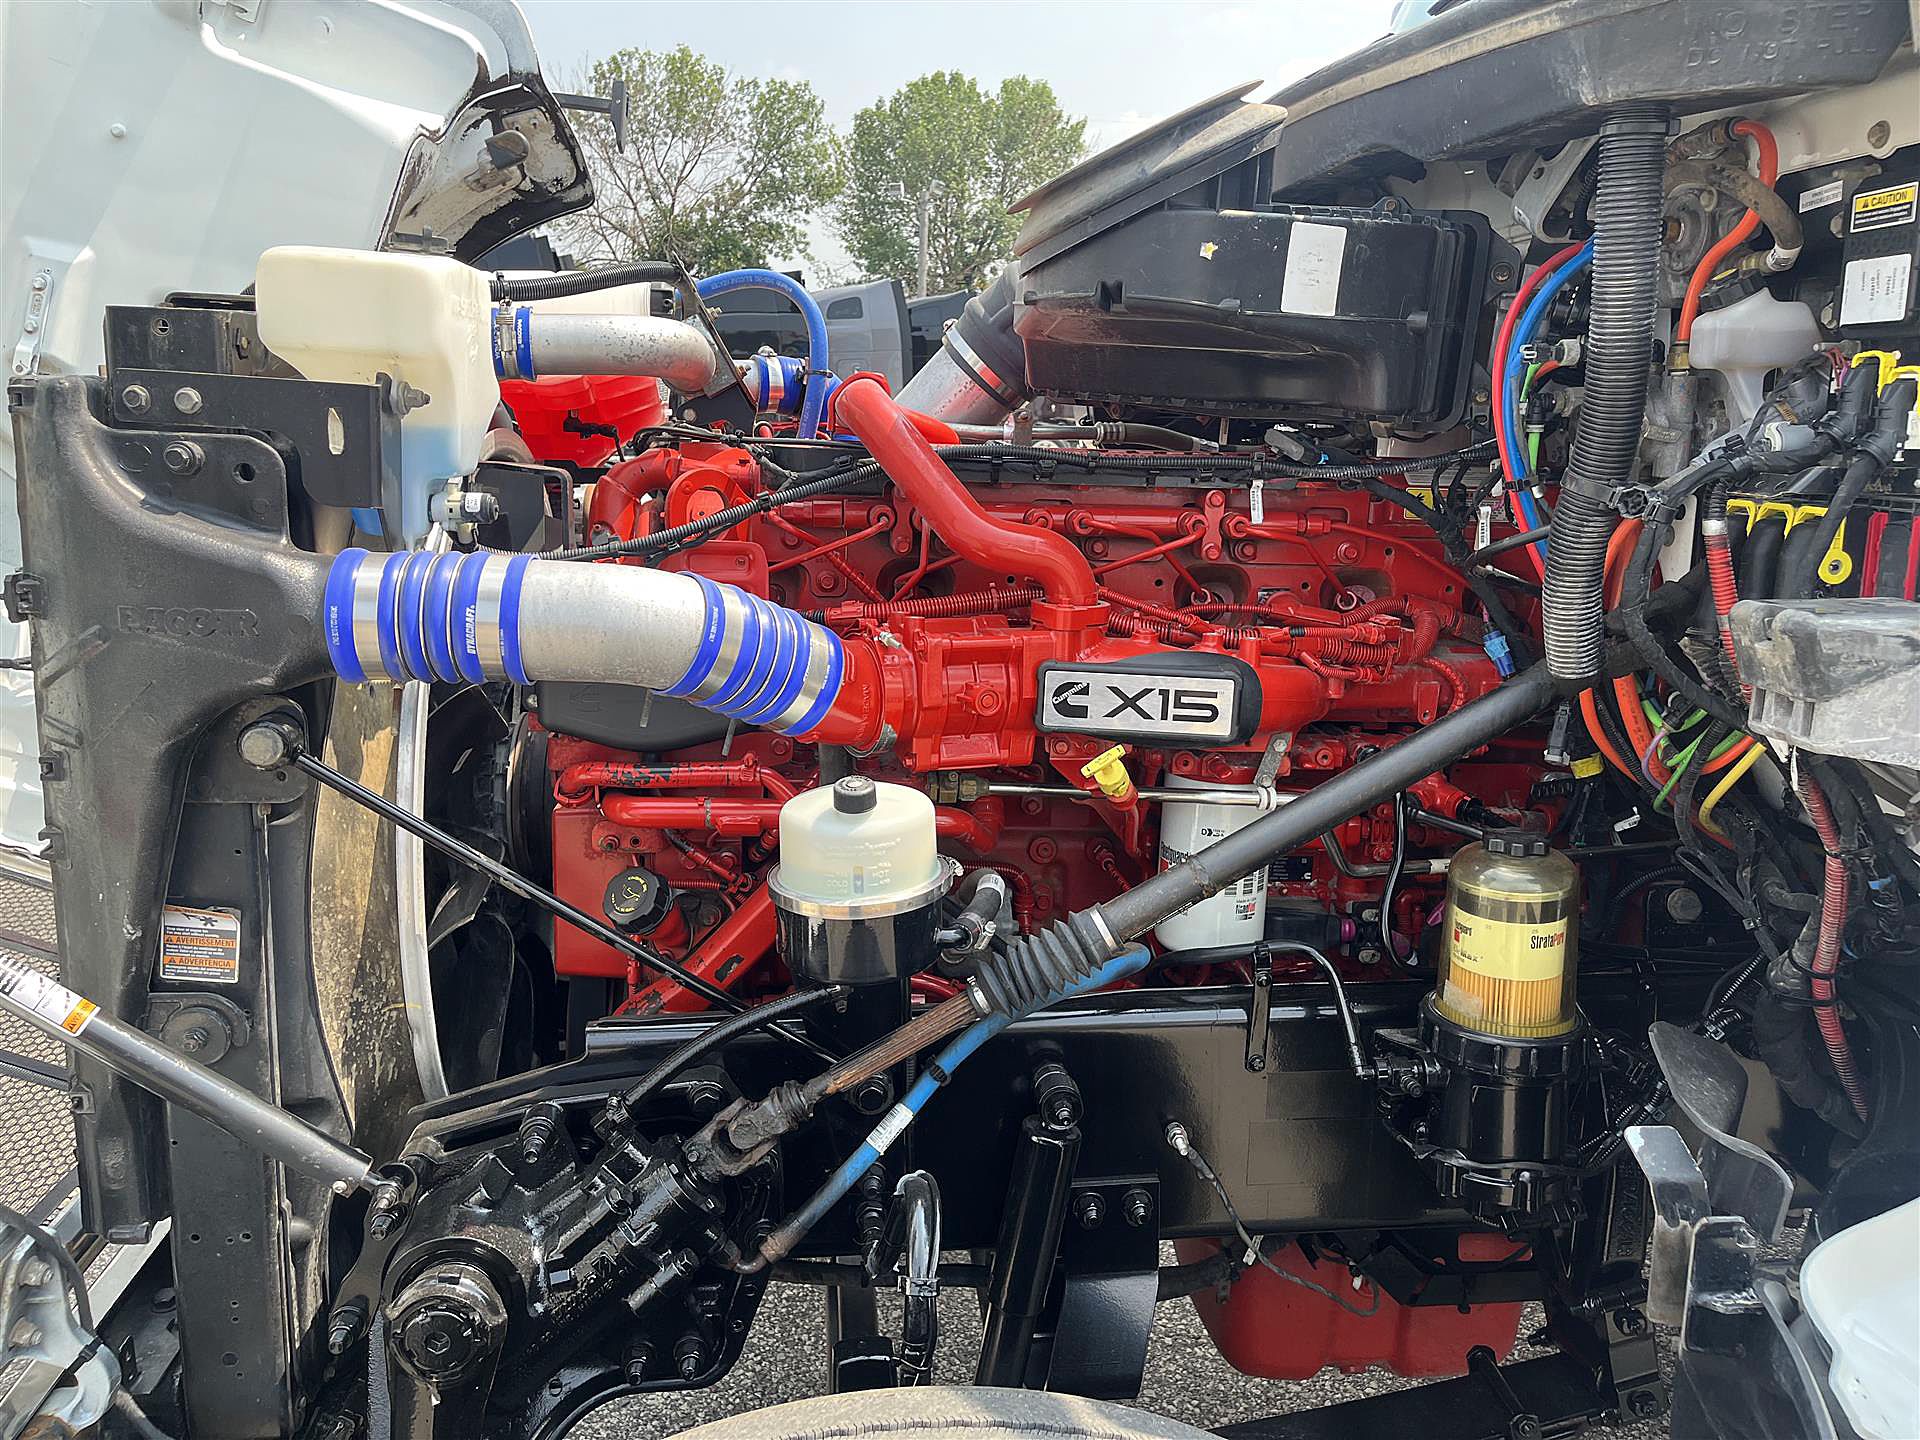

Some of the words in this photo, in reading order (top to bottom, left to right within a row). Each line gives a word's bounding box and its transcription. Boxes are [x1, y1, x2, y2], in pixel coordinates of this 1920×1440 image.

[1871, 191, 1908, 207] CAUTION
[466, 606, 477, 655] DYNACRAFT
[1052, 681, 1088, 705] Cummins
[1102, 685, 1219, 723] X15
[176, 936, 235, 947] AVERTISSEMENT
[179, 957, 231, 967] ADVERTENCIA
